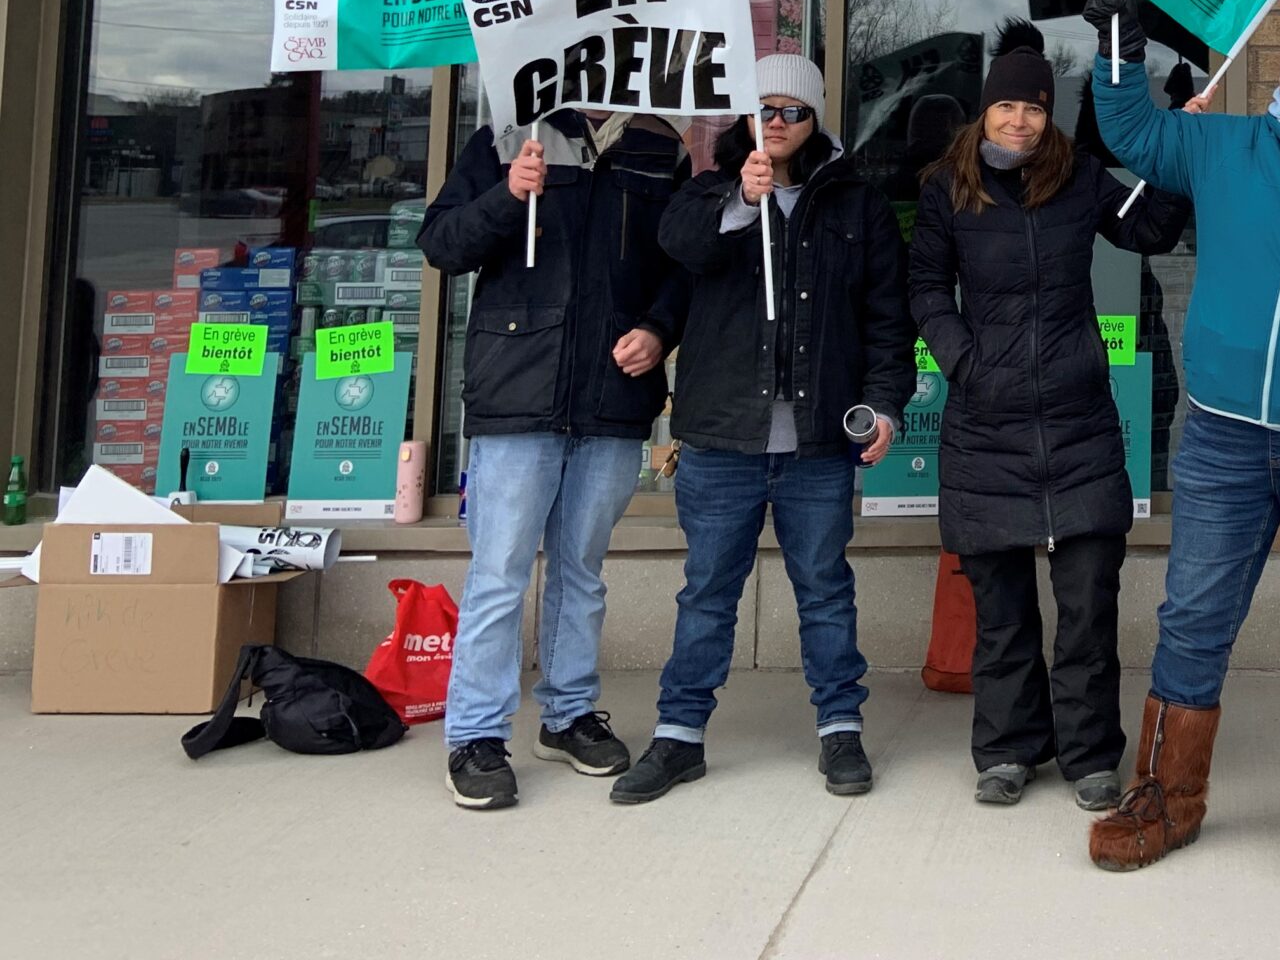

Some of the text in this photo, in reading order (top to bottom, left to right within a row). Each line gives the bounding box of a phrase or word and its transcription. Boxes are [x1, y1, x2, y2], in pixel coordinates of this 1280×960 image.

[285, 0, 318, 10] CSN
[382, 10, 415, 28] POUR
[418, 3, 451, 25] NOTRE
[513, 13, 731, 127] GRÈVE
[1100, 319, 1125, 332] rève
[203, 328, 256, 345] En grève
[329, 328, 382, 346] En grève
[201, 346, 253, 360] bientôt
[330, 345, 382, 362] bientôt
[183, 416, 250, 436] ENSEMBLE
[316, 416, 384, 436] ENSEMBLE
[181, 439, 249, 449] POUR NOTRE AVENIR
[315, 439, 382, 449] POUR NOTRE AVENIR
[906, 435, 928, 445] NOTRE
[404, 632, 451, 652] met
